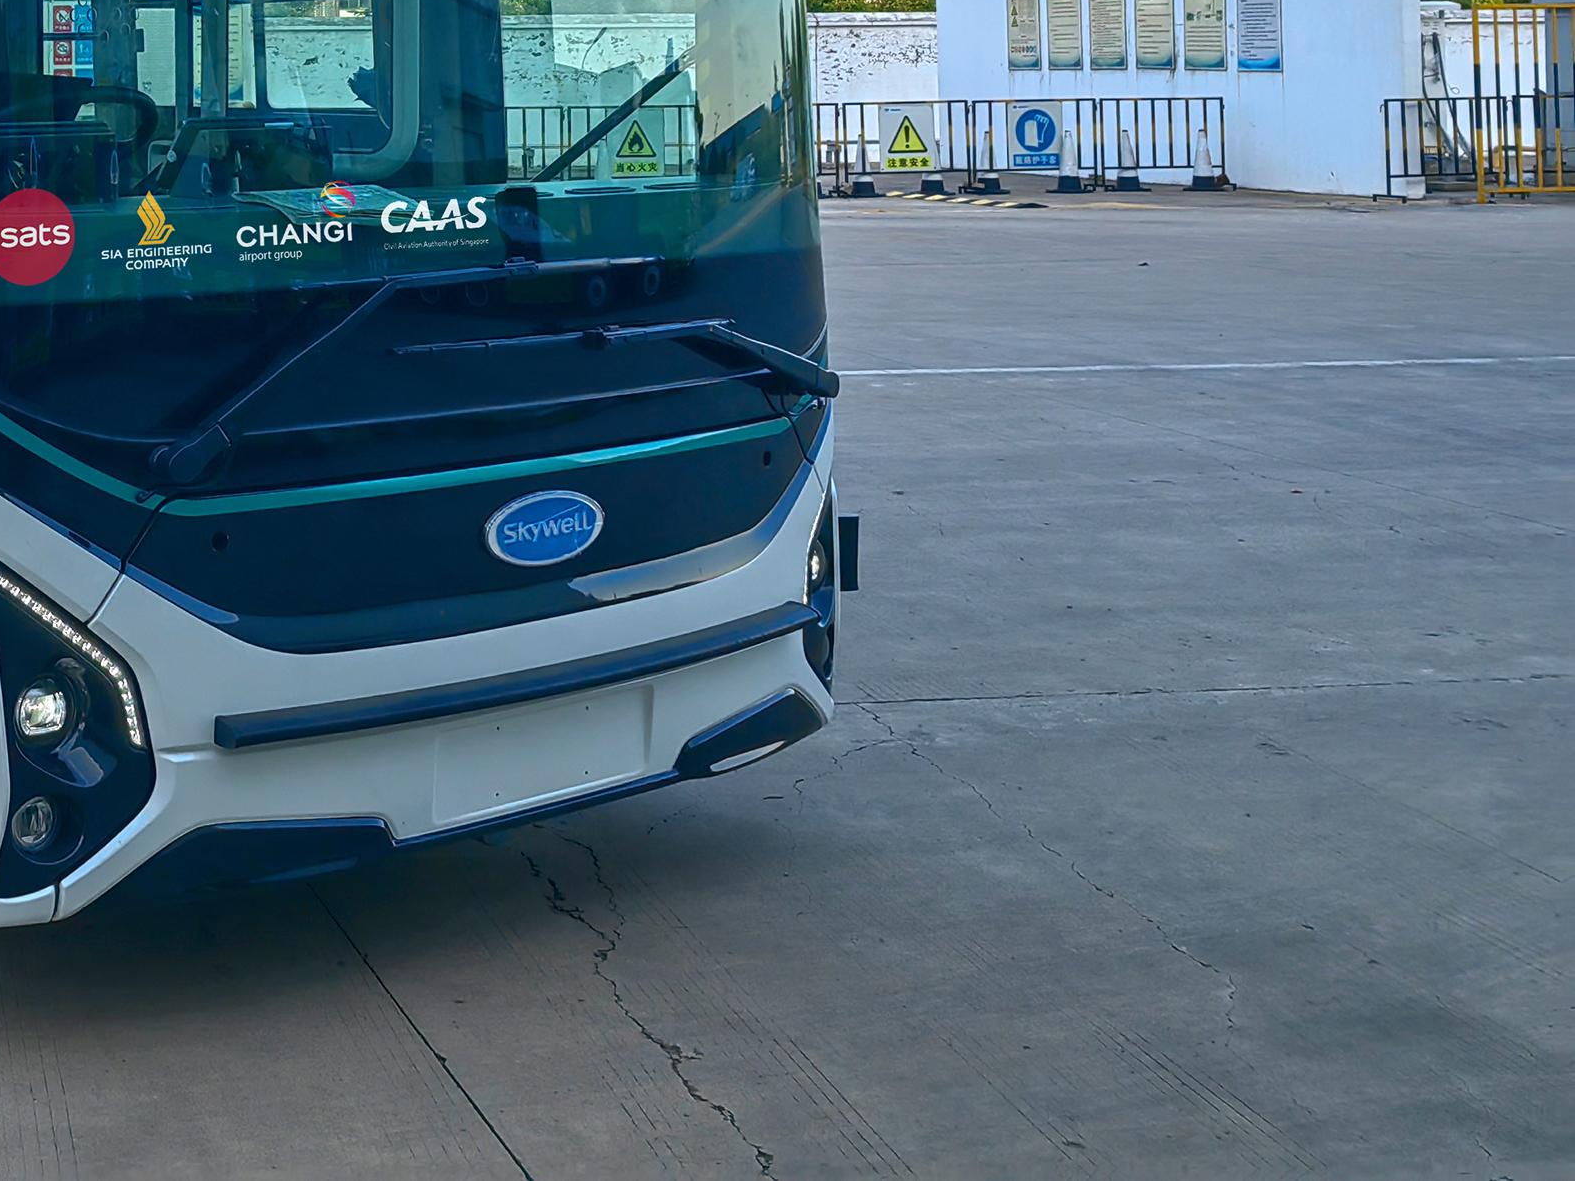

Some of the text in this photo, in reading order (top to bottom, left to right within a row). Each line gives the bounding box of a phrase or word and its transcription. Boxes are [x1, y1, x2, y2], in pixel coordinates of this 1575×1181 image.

[616, 162, 658, 172] 当心火灾
[887, 157, 930, 167] 注意安全
[381, 196, 487, 233] CAAS
[0, 223, 71, 248] sats
[236, 221, 353, 247] CHANGI
[101, 244, 213, 260] SIA ENGINEERING
[239, 250, 303, 262] airport group
[125, 257, 189, 270] COMPANY
